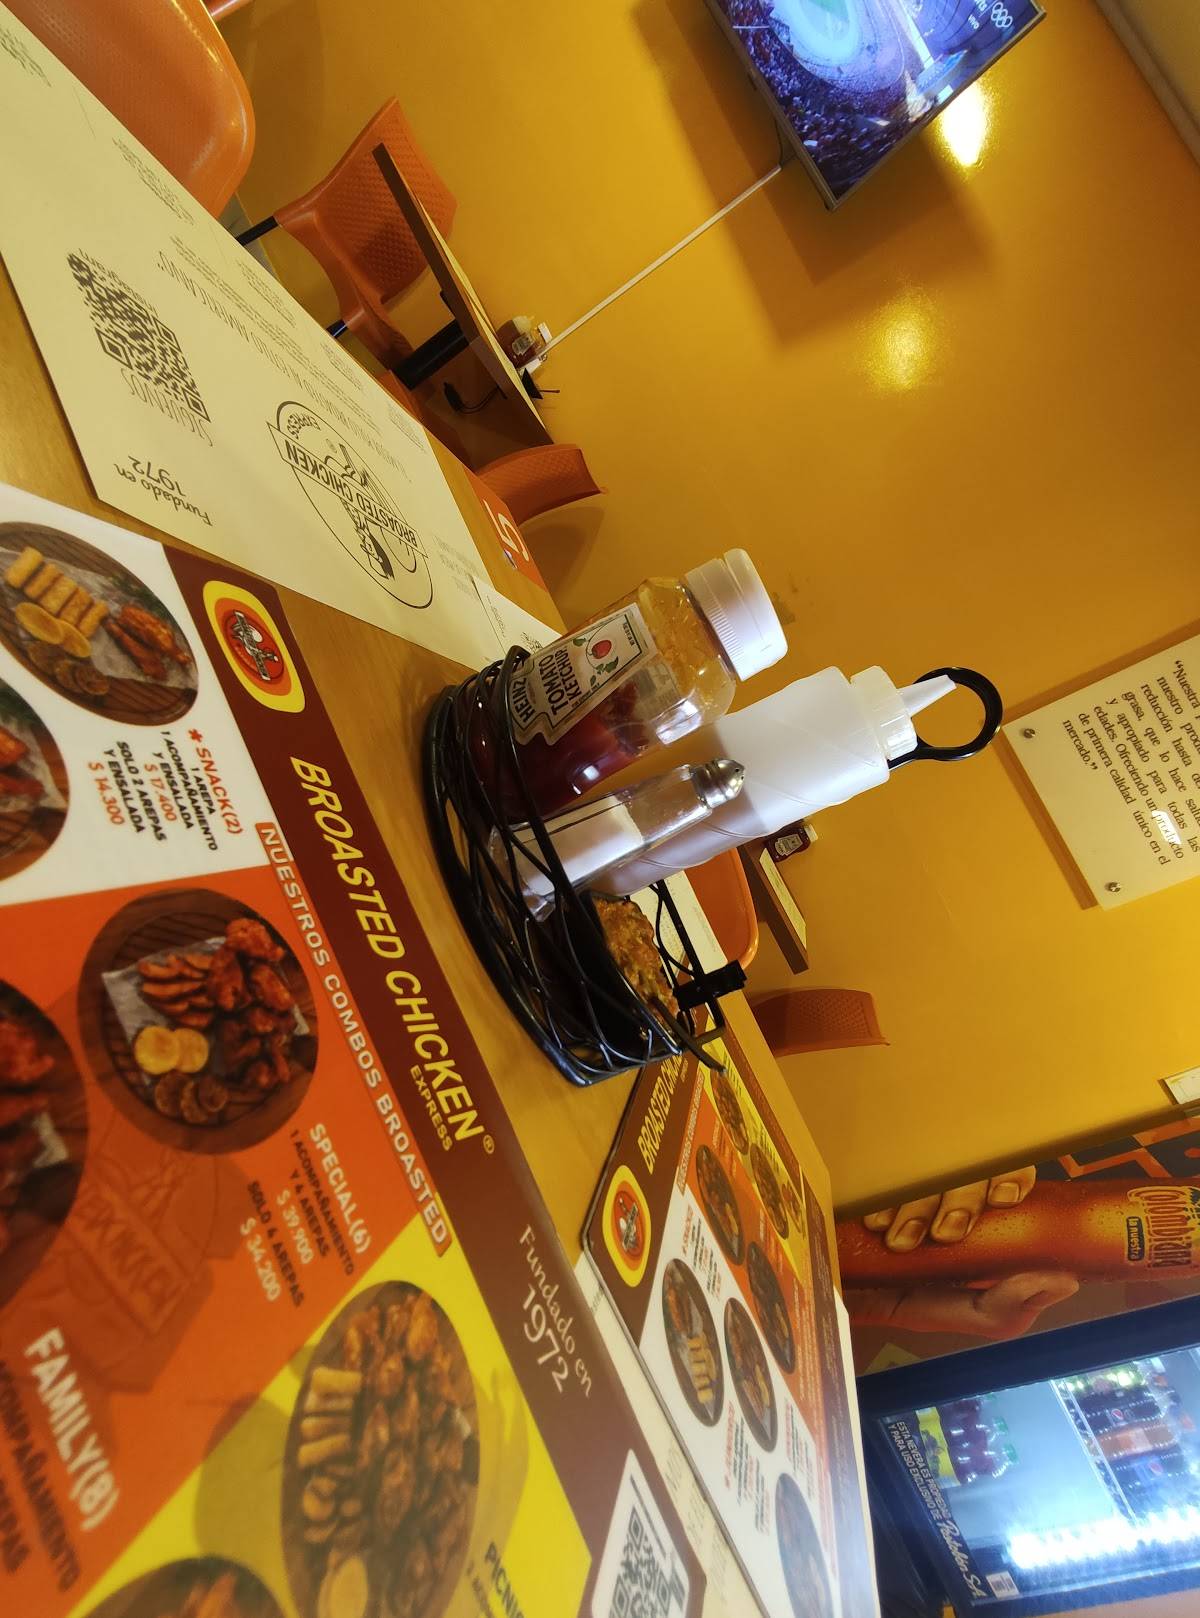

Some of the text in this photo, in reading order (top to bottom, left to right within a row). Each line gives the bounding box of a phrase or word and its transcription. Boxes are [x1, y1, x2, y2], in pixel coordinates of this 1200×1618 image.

[79, 248, 160, 318] Instagram
[286, 417, 320, 439] EXPRESS
[113, 463, 212, 527] Fundado en
[128, 455, 187, 496] 1972
[282, 437, 419, 549] BROASTED CHICKEN
[482, 499, 530, 562] 5
[512, 677, 536, 723] HEINZ
[539, 654, 569, 716] TOMATO
[555, 648, 582, 702] KETCHUP
[1156, 675, 1185, 716] nuestro
[1168, 659, 1200, 709] “Nuestra
[1061, 718, 1098, 772] mercado.”
[1121, 689, 1146, 721] grasa,
[1141, 725, 1161, 748] que
[1158, 750, 1172, 763] lo
[1167, 766, 1189, 793] hace
[1139, 682, 1195, 767] reducción hasta
[87, 760, 125, 826] $ 14.300
[106, 760, 146, 834] ENSALADA
[116, 740, 167, 842] SOLO 2 AREPAS
[143, 760, 177, 822] $ 17.400
[158, 762, 194, 829] ENSALADA
[163, 738, 218, 851] ACOMPAÑAMIENTO
[193, 774, 216, 815] AREPA
[195, 746, 243, 832] SNACK(2)
[1077, 711, 1171, 865] de primera calidad único en el
[1092, 703, 1188, 860] edades. Ofreciendo un producto
[1106, 696, 1200, 853] y apropiado para todas las
[288, 758, 486, 1143] BROASTED CHICKEN
[259, 824, 450, 1246] NUESTROS COMBOS BROASTED
[407, 1064, 456, 1151] EXPRESS
[637, 1075, 671, 1175] BROASTED
[288, 1128, 356, 1276] 1 ACOMPAÑAMIENTO
[298, 1196, 331, 1257] AREPAS
[307, 1122, 375, 1254] SPECIAL(6)
[1127, 1186, 1195, 1267] Colombiana
[245, 1179, 273, 1225] SOLO
[270, 1240, 306, 1307] AREPAS
[245, 1233, 284, 1302] 34.200
[280, 1204, 316, 1265] 39.900
[1128, 1218, 1140, 1259] la nuestra
[517, 1223, 587, 1397] Fundado en
[522, 1282, 563, 1392] 1972
[24, 1328, 120, 1531] FAMILY(8)
[896, 1420, 951, 1519] ESTA NEVERA ES PROPIEDAD
[890, 1429, 907, 1450] PARA
[900, 1449, 915, 1467] USO
[908, 1466, 936, 1509] EXCLUSIVO
[929, 1507, 942, 1521] DE
